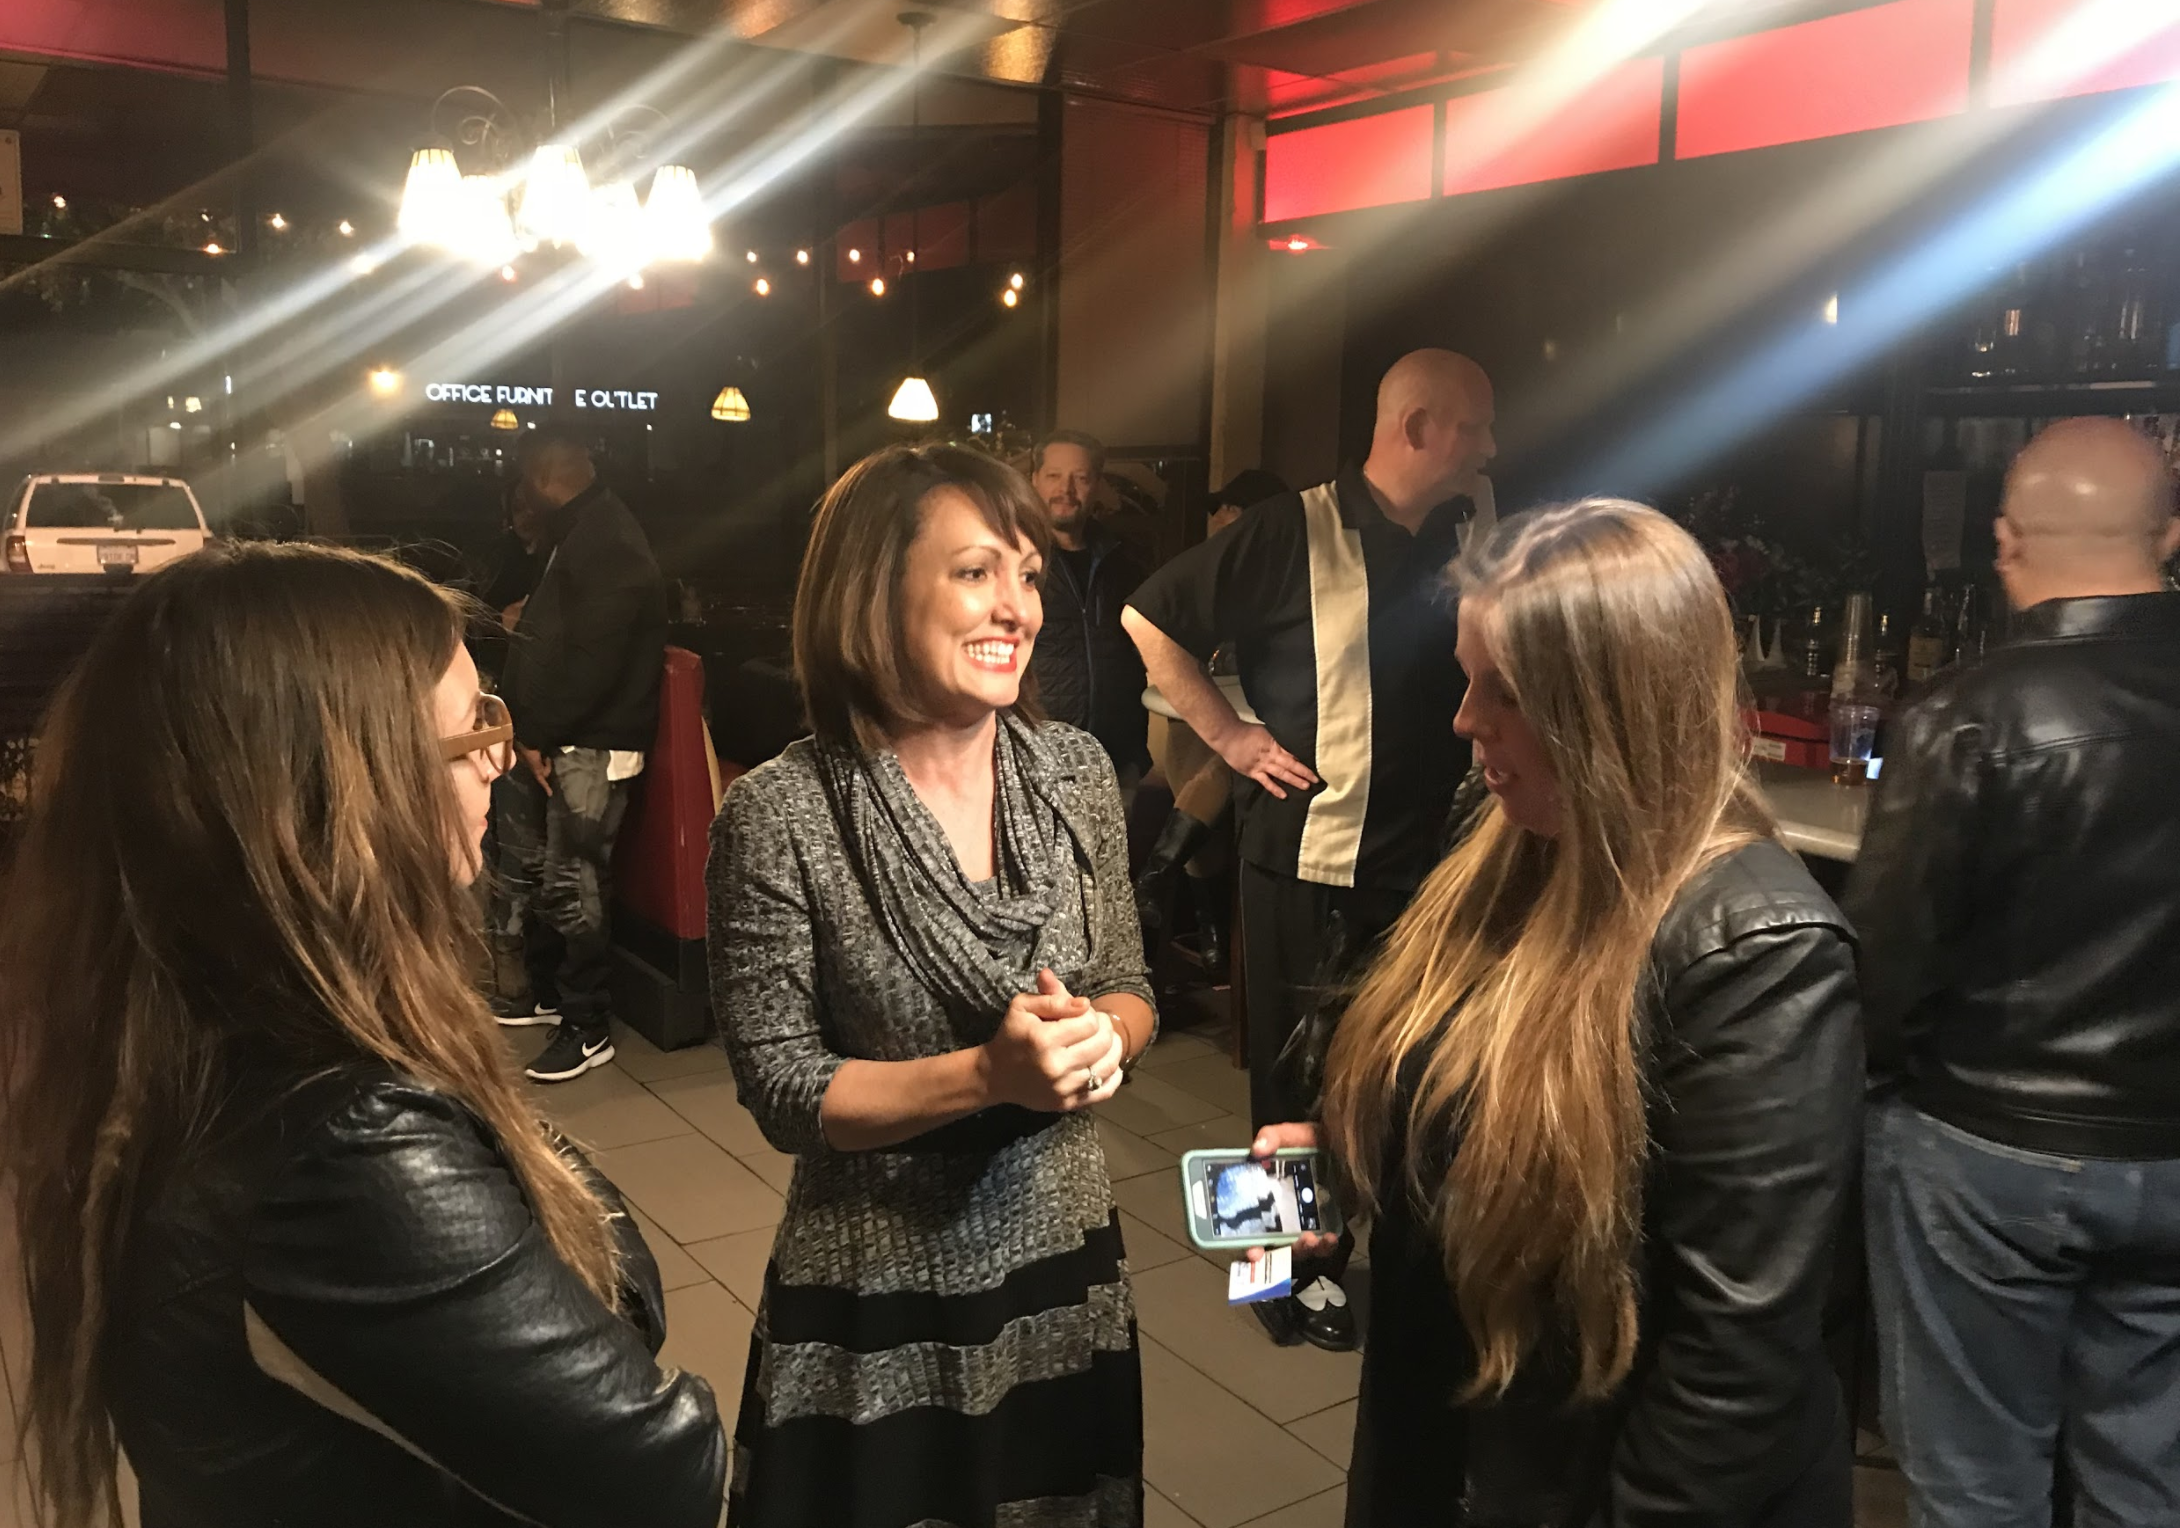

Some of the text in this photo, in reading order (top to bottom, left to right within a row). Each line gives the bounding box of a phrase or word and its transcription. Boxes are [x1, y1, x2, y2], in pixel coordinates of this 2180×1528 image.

[425, 383, 659, 410] OFFICE FURNITE OUTLET
